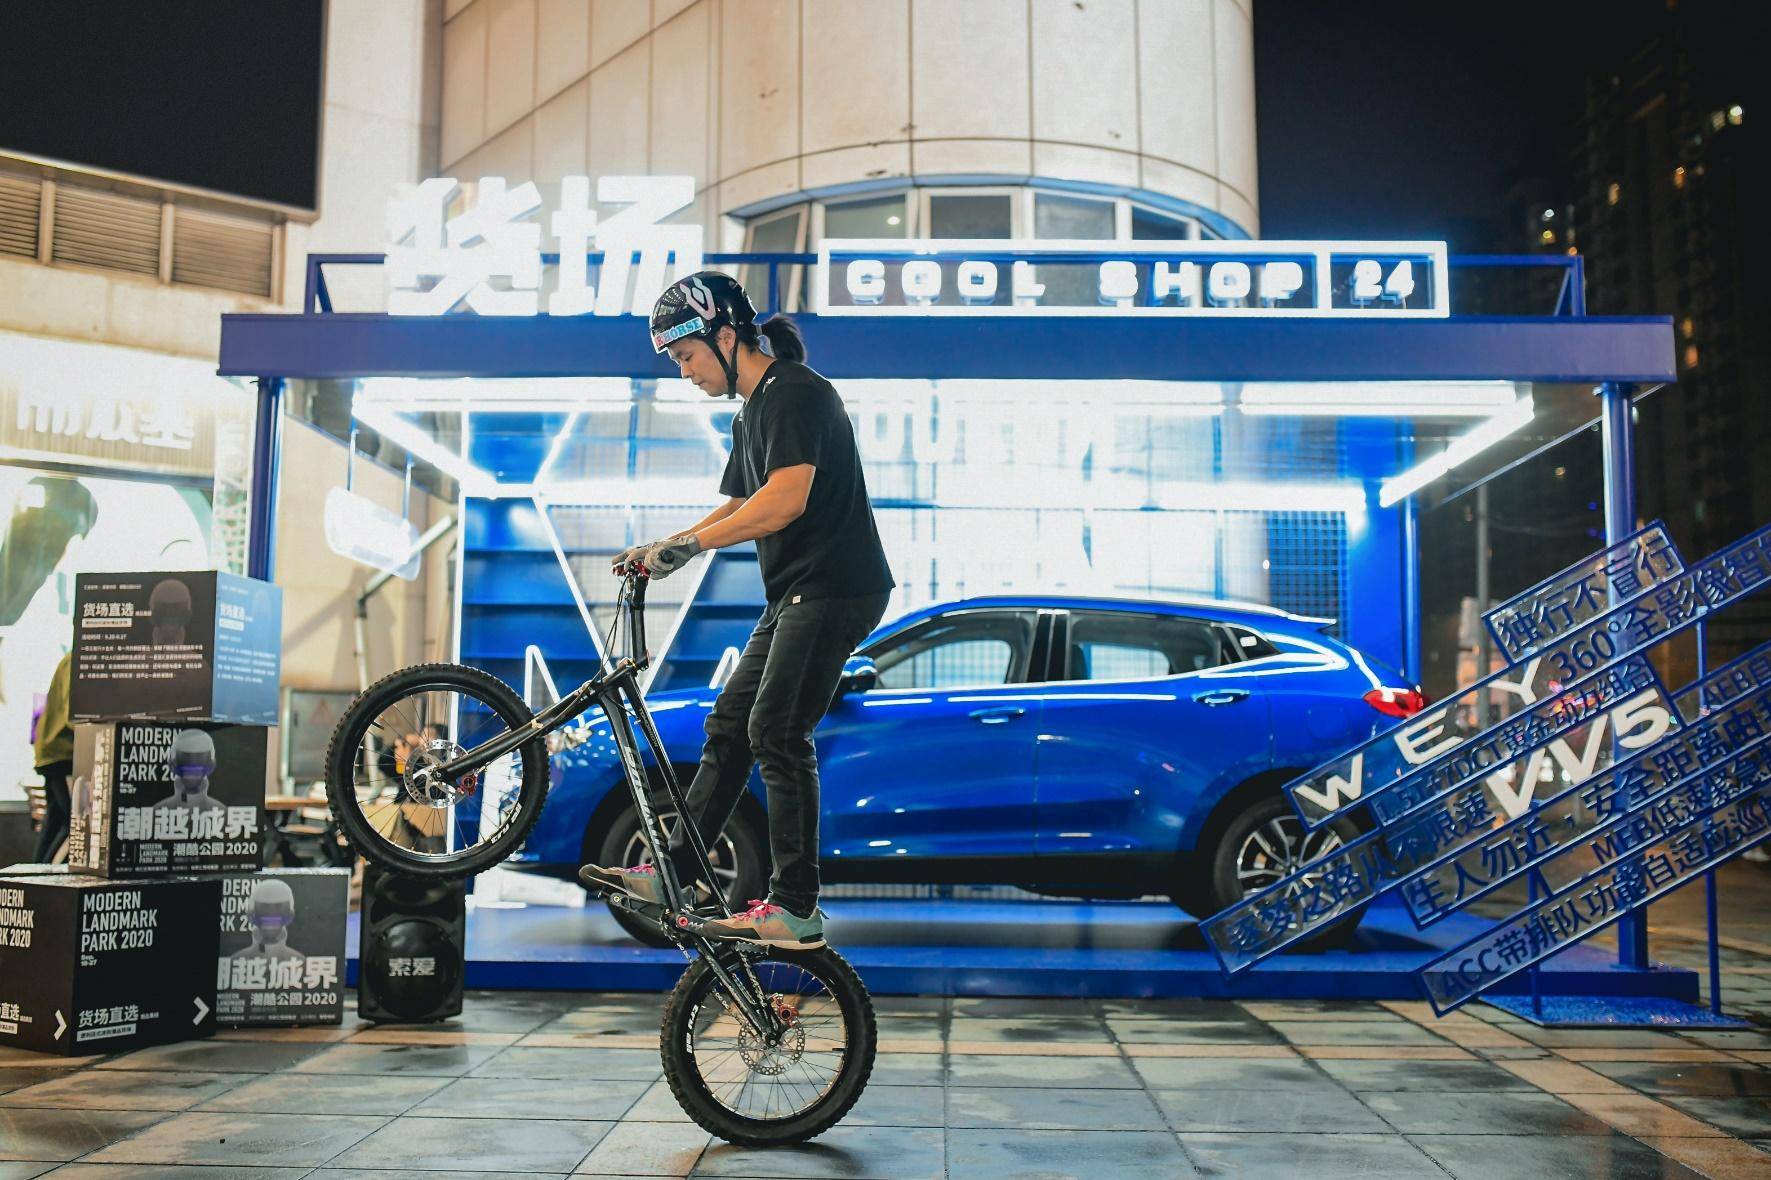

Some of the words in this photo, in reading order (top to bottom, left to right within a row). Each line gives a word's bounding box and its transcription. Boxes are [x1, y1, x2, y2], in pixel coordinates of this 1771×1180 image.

[846, 259, 1046, 301] COOL
[1098, 259, 1303, 301] SHOP
[1352, 259, 1415, 300] 24
[1498, 536, 1678, 652] 独行不盲行
[83, 602, 134, 617] 货场直选
[1294, 657, 1542, 812] WEY
[1549, 537, 1771, 683] 360°全影像智
[121, 727, 182, 745] MODERN
[120, 745, 172, 764] LANDM
[1485, 687, 1670, 820] VV5
[119, 764, 157, 782] PARK
[117, 806, 258, 841] 潮越城界
[226, 842, 257, 855] 2020
[222, 878, 260, 896] DERN
[0, 888, 24, 908] DERN
[83, 890, 141, 913] MODERN
[82, 909, 158, 933] LANDMARK
[10, 929, 31, 948] 2020
[81, 933, 118, 953] PARK
[121, 929, 153, 949] 2020
[304, 992, 337, 1005] 2020
[0, 1003, 20, 1021] 直选
[79, 1004, 139, 1028] 货场直选
